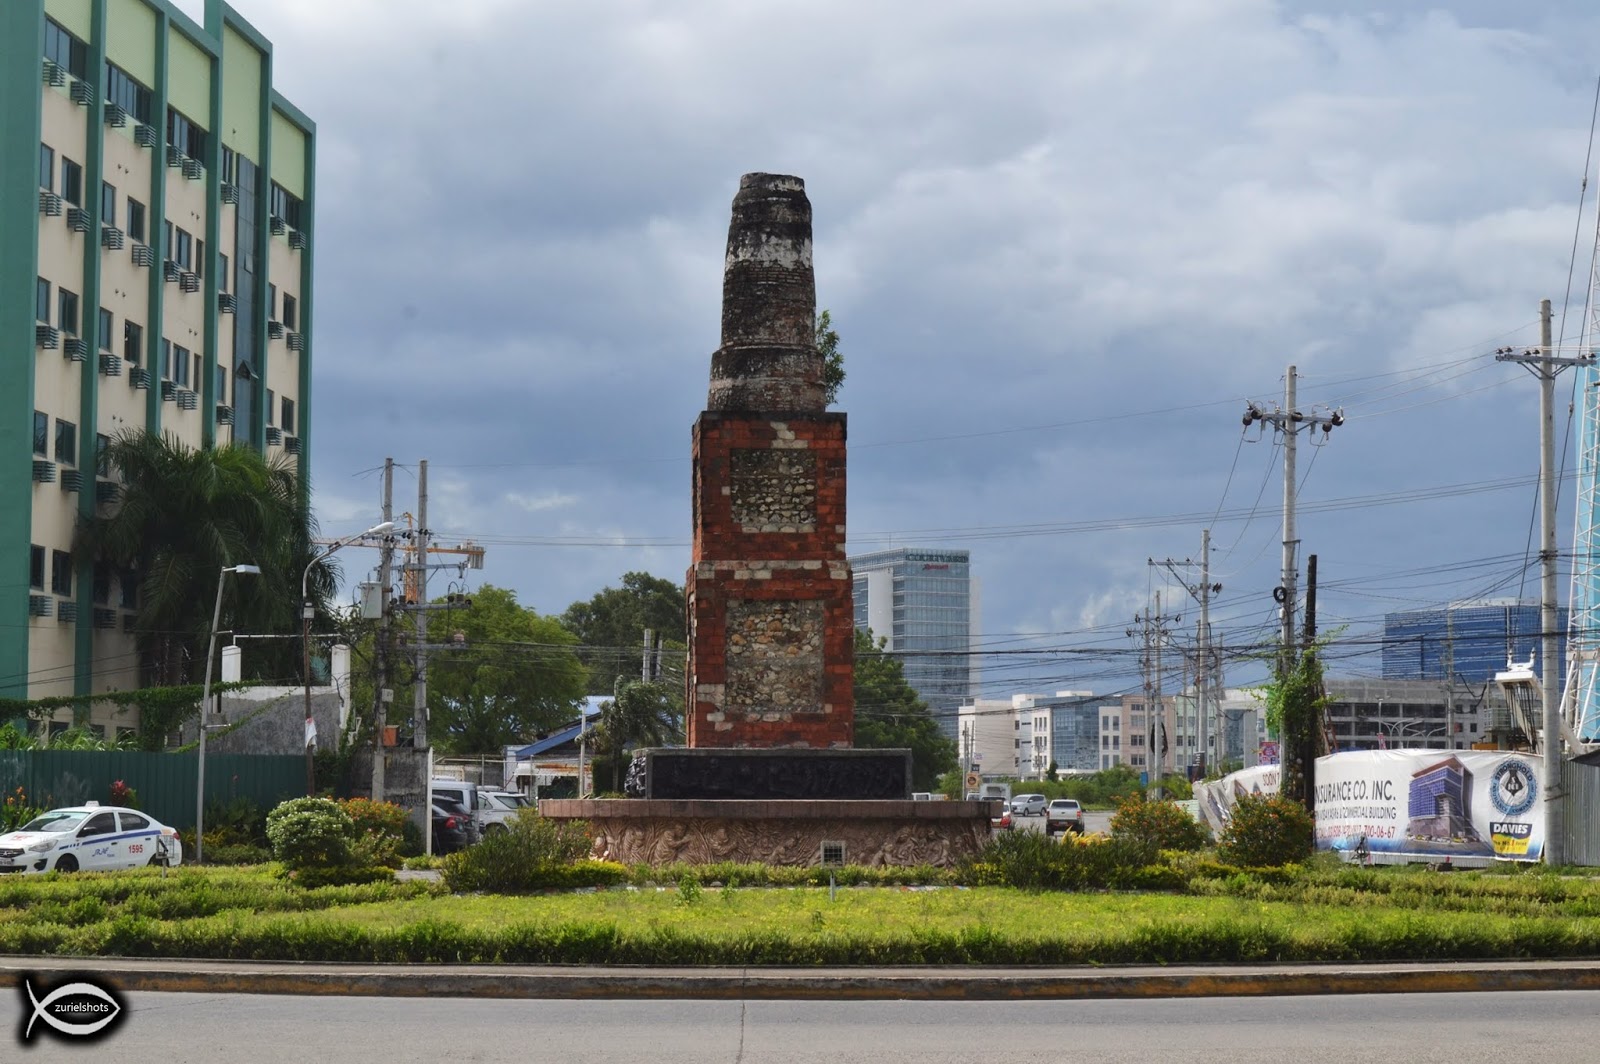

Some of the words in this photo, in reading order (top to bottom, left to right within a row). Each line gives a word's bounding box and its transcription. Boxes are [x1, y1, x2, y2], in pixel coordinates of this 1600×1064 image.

[1495, 763, 1533, 781] STRONGHOLD
[1314, 781, 1351, 804] NSURANCE
[1353, 780, 1368, 800] CO.
[1372, 780, 1396, 800] INC.
[1369, 806, 1397, 819] BUILDING
[1493, 823, 1529, 834] DAVIES
[128, 844, 144, 854] 1595
